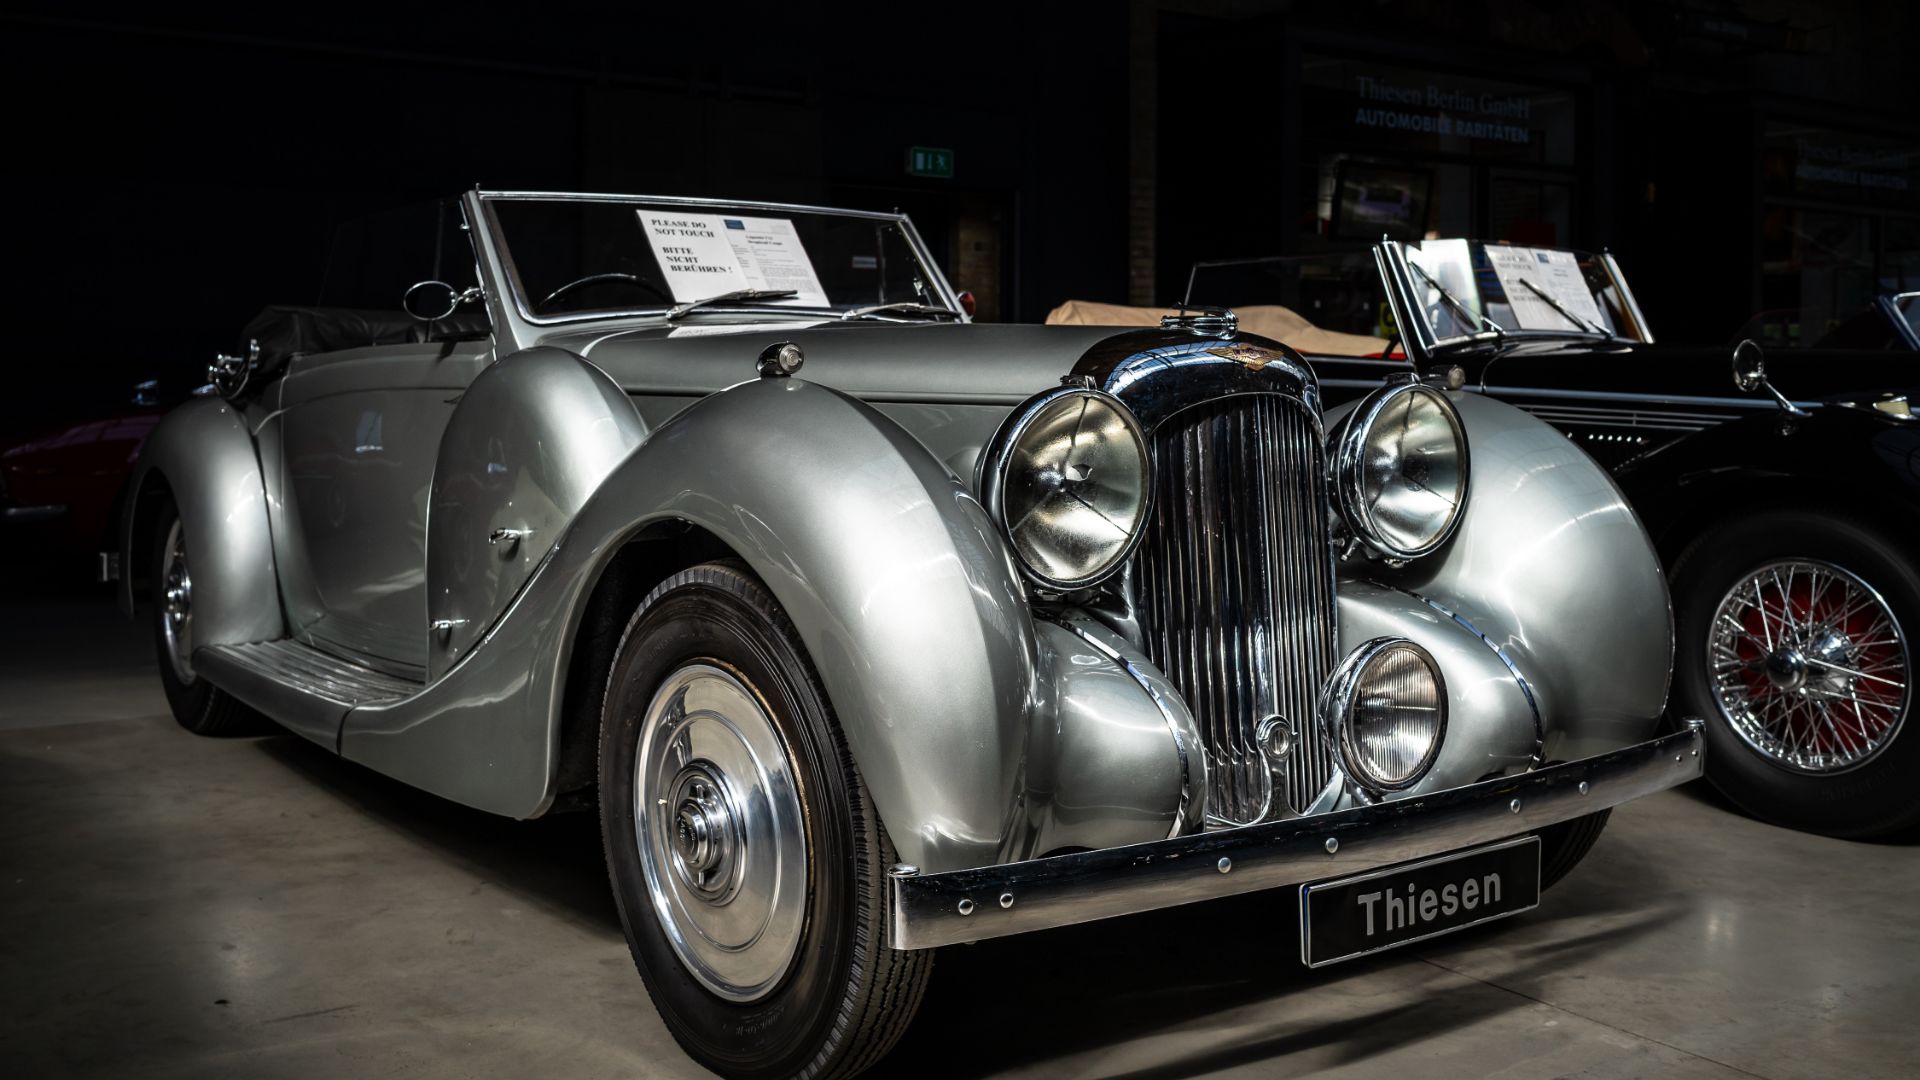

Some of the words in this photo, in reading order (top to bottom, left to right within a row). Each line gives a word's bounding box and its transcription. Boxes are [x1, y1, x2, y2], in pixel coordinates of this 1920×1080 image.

[1355, 75, 1422, 104] Thiesen
[1426, 85, 1475, 112] Berlin
[1479, 92, 1531, 119] GmbH
[1355, 107, 1452, 134] AUTOMOBILE
[1456, 118, 1529, 143] RARITÄTEN
[651, 219, 689, 228] PLEASE
[691, 221, 707, 229] DO
[654, 228, 676, 236] NOT
[679, 229, 715, 238] TOUCH
[662, 246, 694, 255] BITTE
[666, 255, 699, 264] NICHT
[1357, 872, 1501, 937] Thiesen
